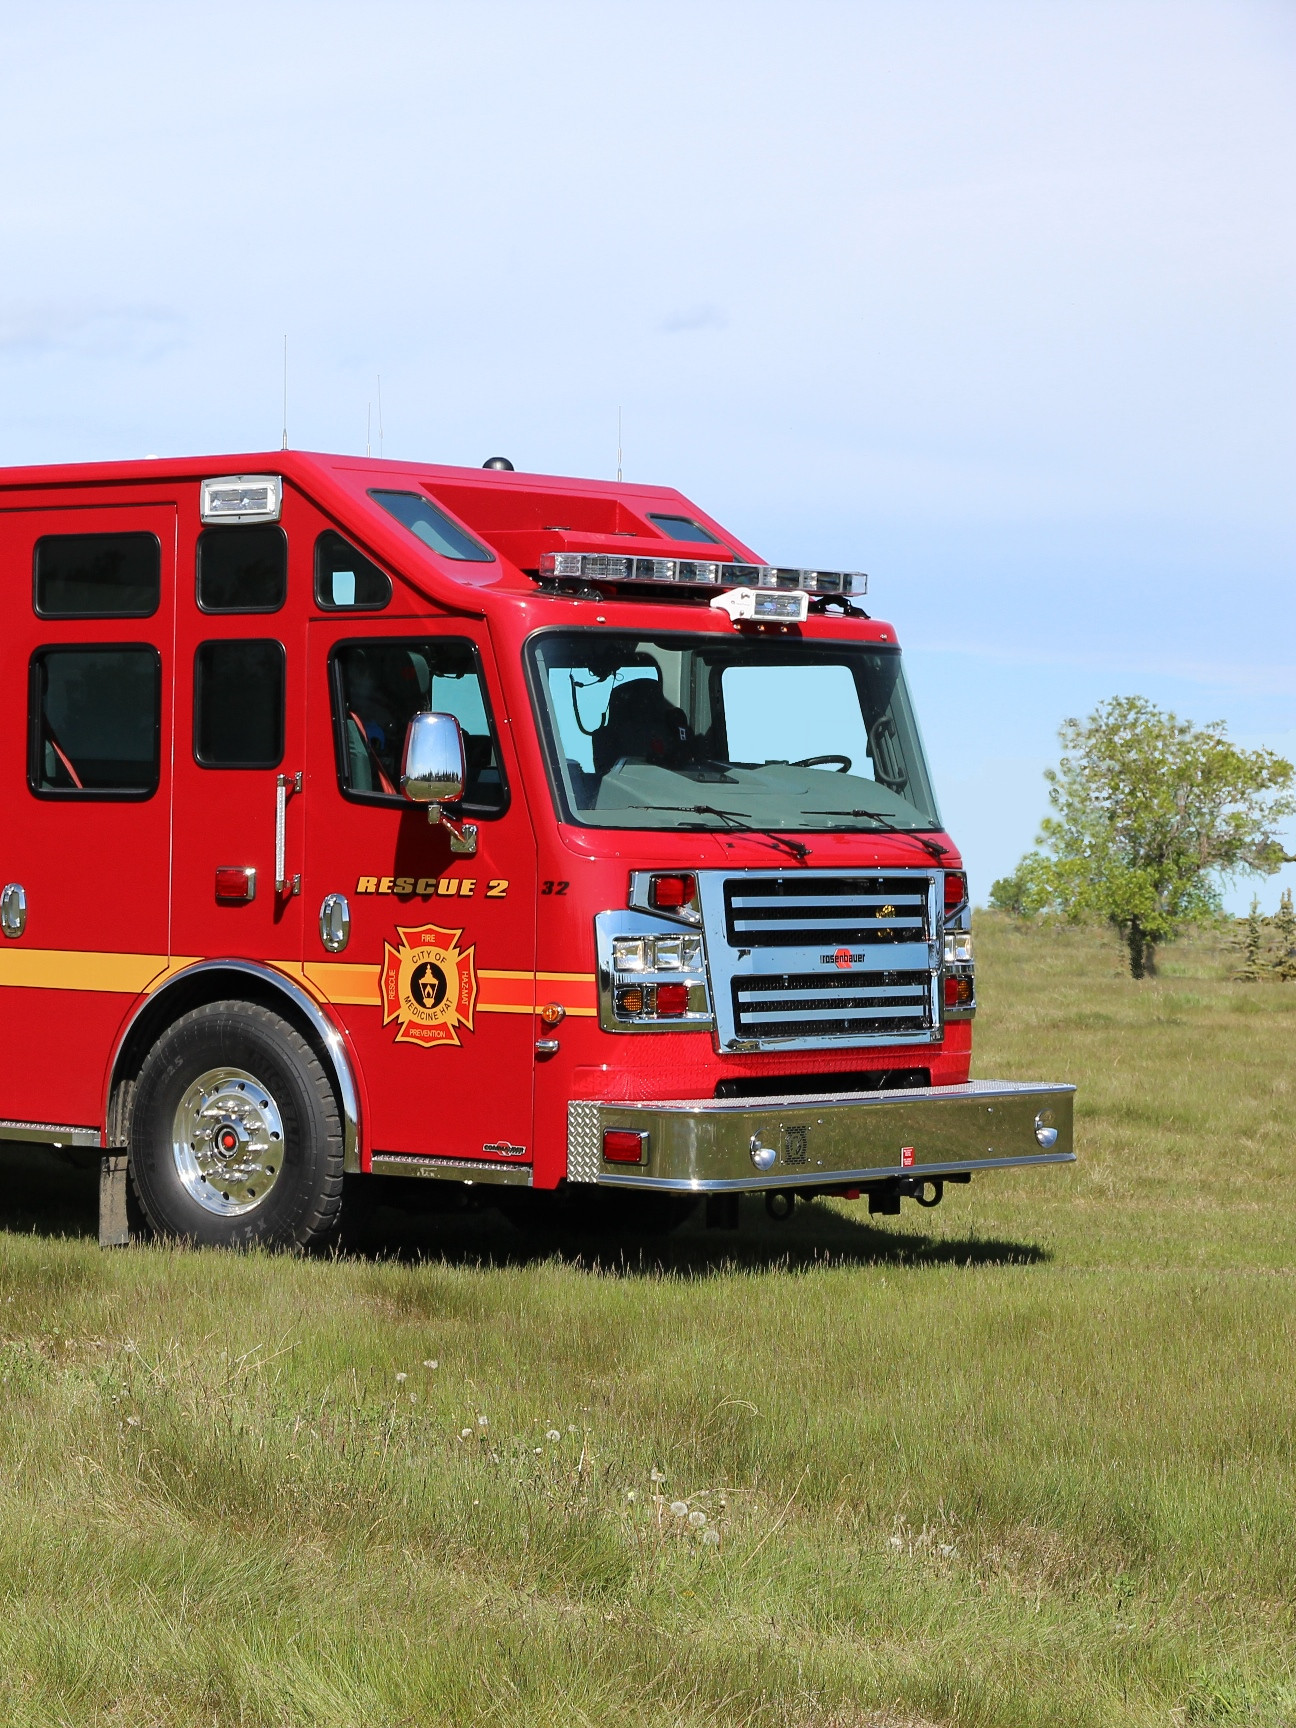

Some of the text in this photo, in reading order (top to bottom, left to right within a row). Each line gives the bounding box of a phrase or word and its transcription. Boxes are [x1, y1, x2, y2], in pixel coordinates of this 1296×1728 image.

[355, 876, 509, 899] RESCUE 2
[541, 880, 570, 896] 32
[421, 934, 436, 943] FIRE
[411, 950, 447, 964] CITY OF
[821, 952, 865, 963] rosenbauer
[388, 969, 396, 1000] RESCUE
[461, 970, 469, 1006] HAZ-MAT
[404, 995, 453, 1021] MEDICINE HAT
[409, 1028, 446, 1038] PREVENTION
